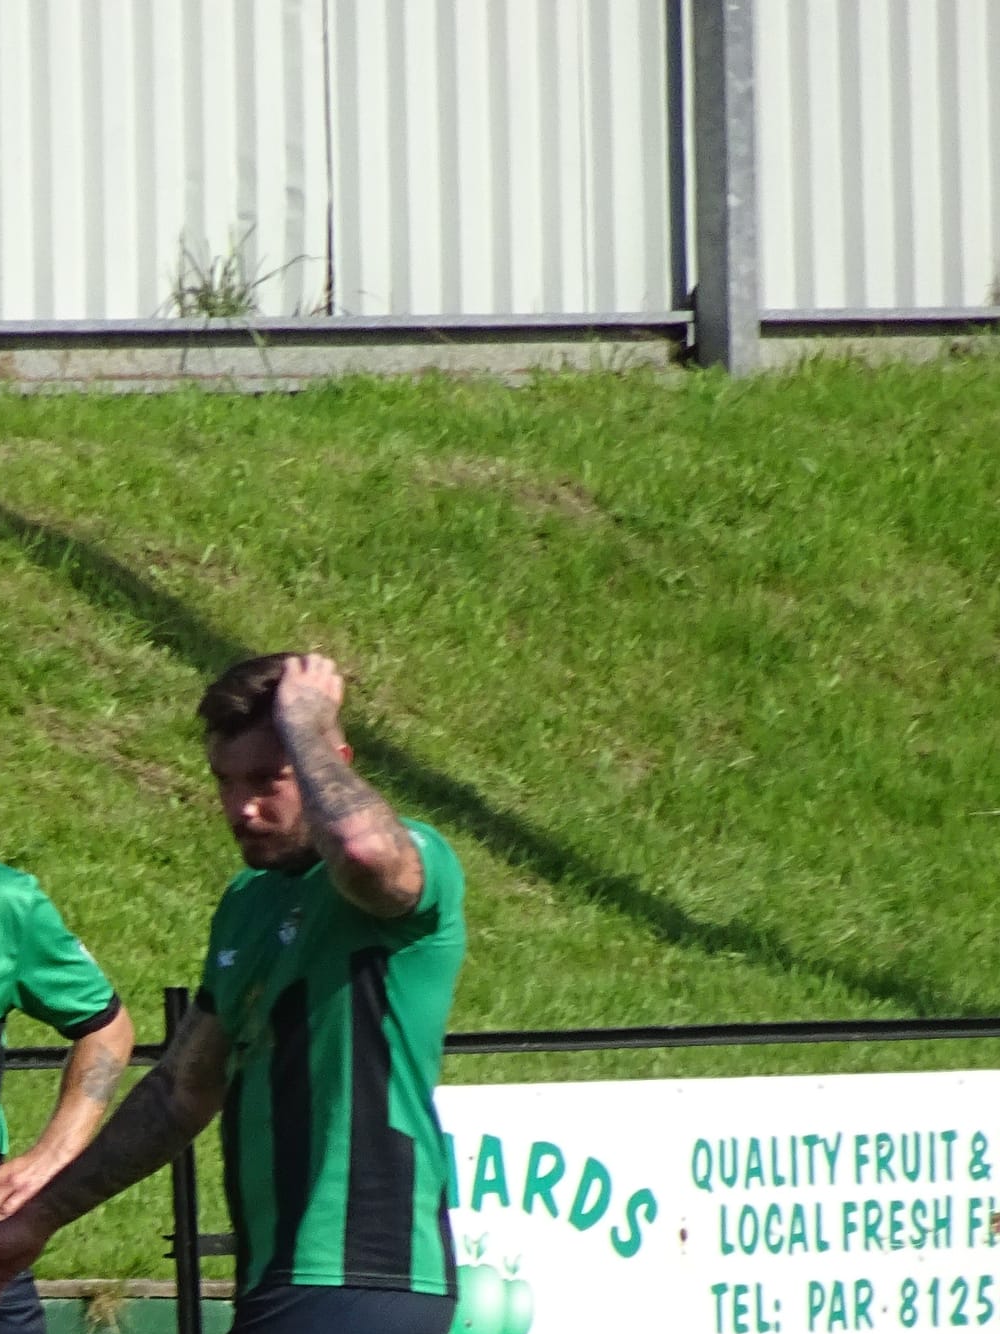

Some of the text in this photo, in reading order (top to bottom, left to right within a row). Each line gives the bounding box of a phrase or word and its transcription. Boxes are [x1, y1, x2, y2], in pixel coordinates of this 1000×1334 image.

[692, 1130, 991, 1192] QUALITY FRUIT &
[721, 1203, 830, 1255] LOCAL
[843, 1196, 952, 1251] FRESH
[711, 1283, 781, 1334] TEL:
[809, 1279, 874, 1332] PAR
